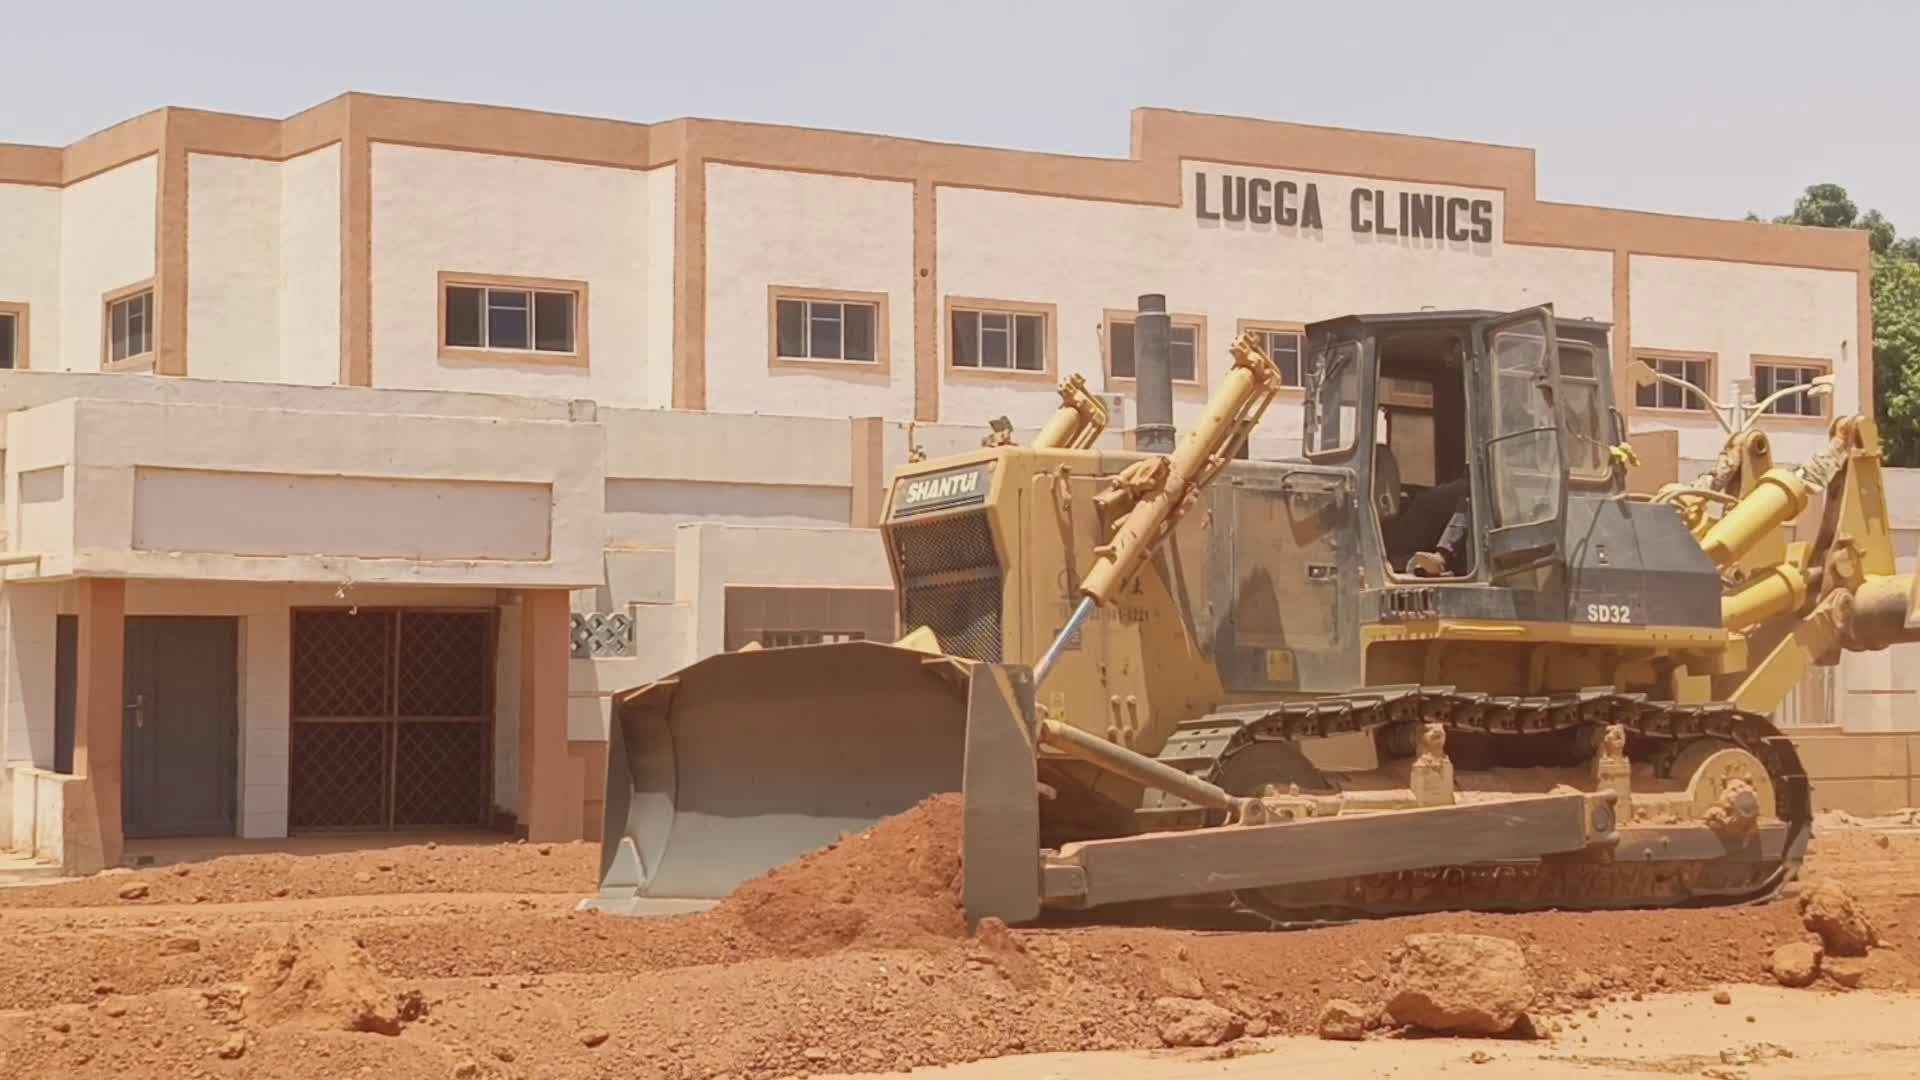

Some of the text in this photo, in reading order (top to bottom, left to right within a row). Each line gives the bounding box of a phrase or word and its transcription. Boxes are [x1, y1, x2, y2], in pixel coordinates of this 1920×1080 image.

[1195, 171, 1493, 244] LUGGA CLINICS
[906, 471, 979, 504] SHANTUI
[1587, 603, 1632, 624] SD32
